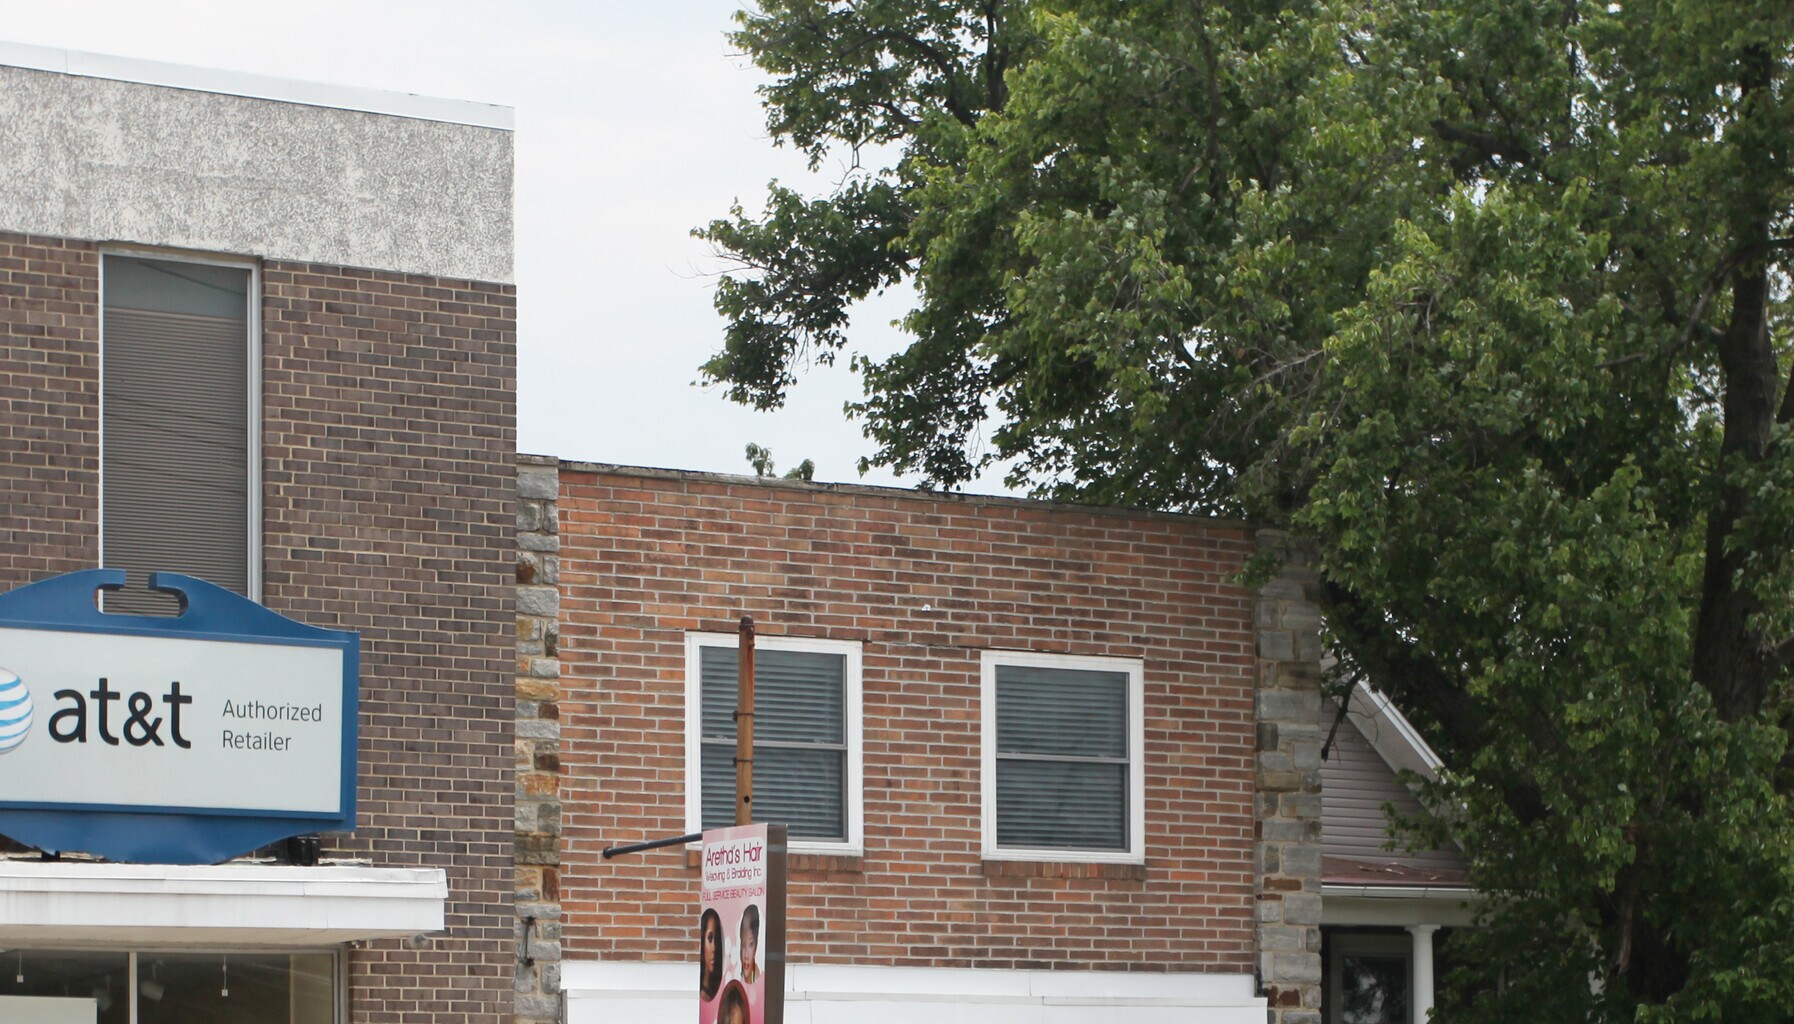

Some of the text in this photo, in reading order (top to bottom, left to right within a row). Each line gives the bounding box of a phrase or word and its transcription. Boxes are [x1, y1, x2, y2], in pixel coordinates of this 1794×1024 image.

[48, 678, 192, 749] at&t
[222, 699, 322, 722] Authorized
[222, 730, 292, 751] Retailer
[705, 842, 762, 867] Aretha's Hair
[730, 888, 747, 899] BEAUTY
[748, 887, 765, 897] SALON
